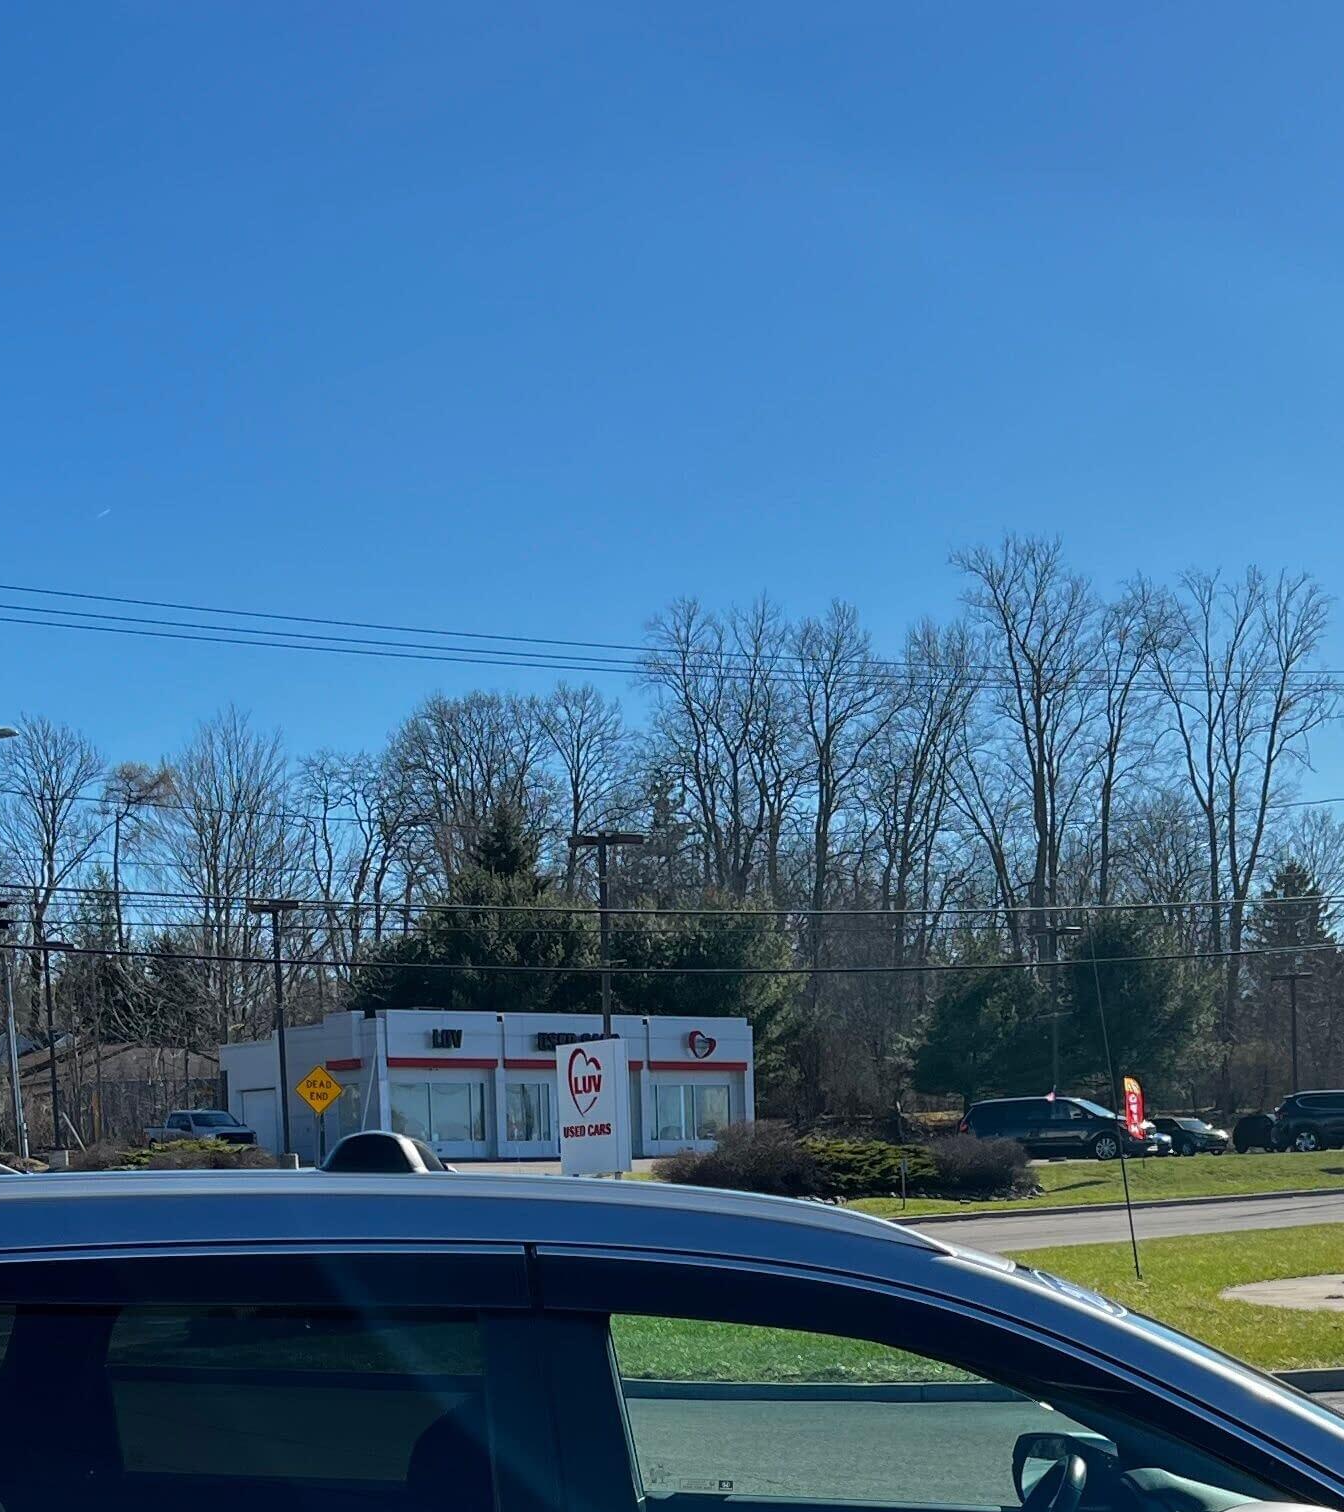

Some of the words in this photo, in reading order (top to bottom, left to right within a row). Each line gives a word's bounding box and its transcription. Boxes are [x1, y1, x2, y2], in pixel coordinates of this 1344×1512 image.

[306, 1080, 332, 1089] DEAD
[574, 1075, 601, 1094] LUV
[309, 1092, 329, 1101] END
[563, 1126, 586, 1139] USED
[587, 1123, 611, 1137] CARS
